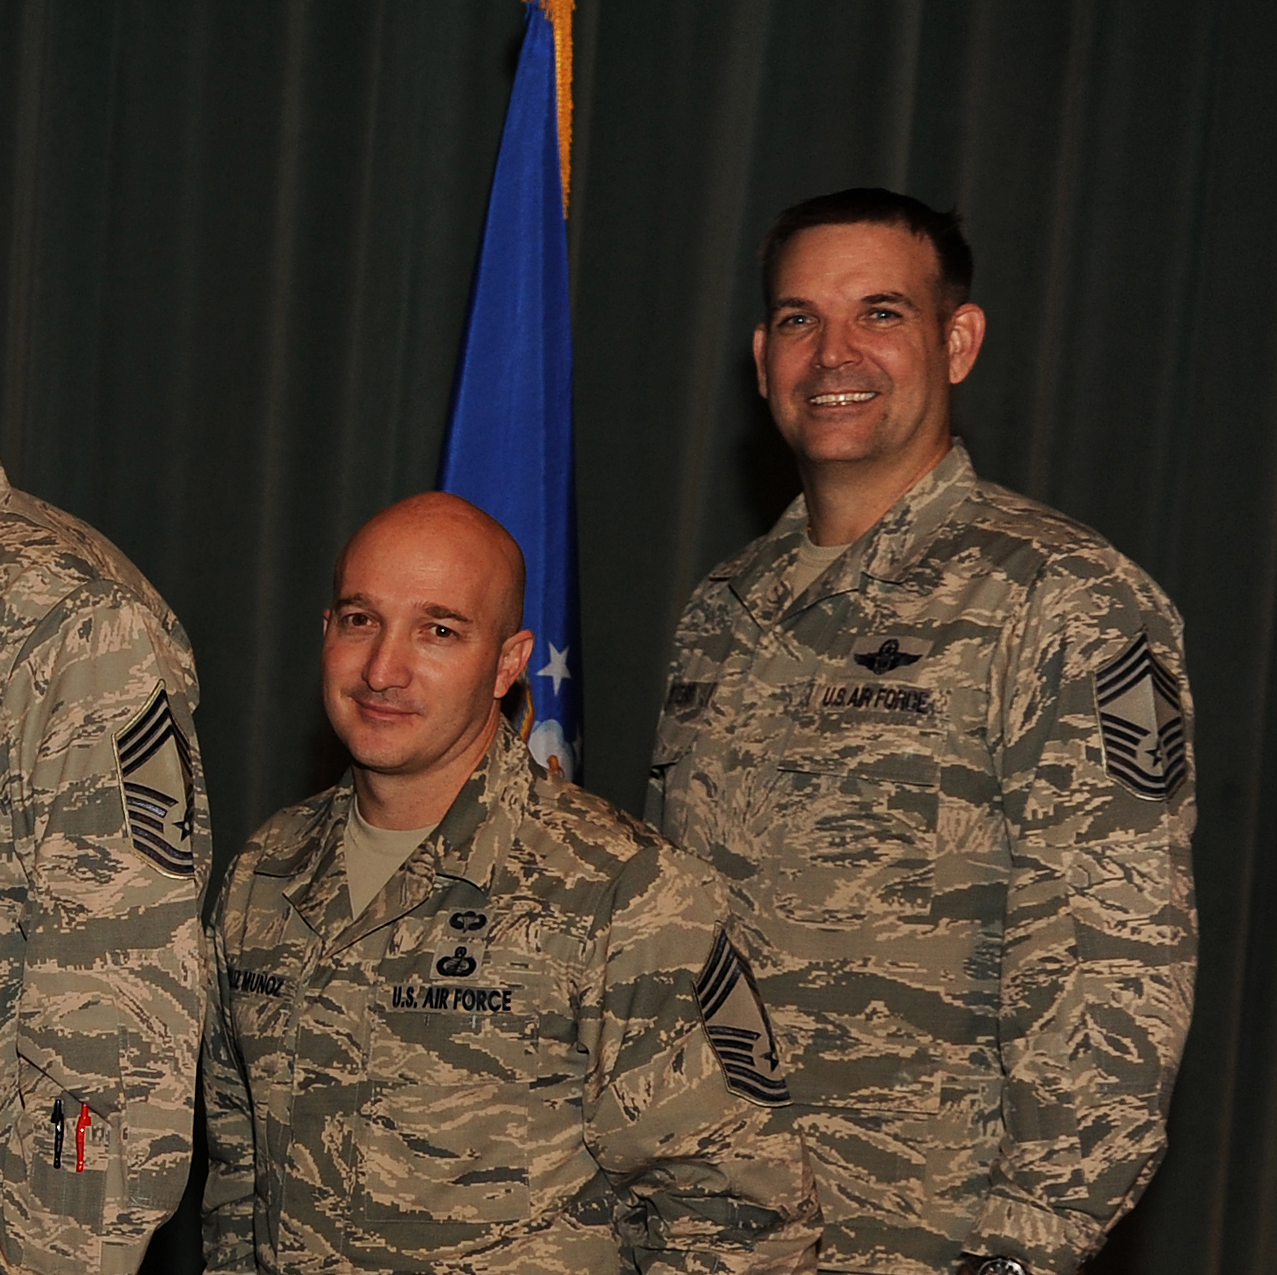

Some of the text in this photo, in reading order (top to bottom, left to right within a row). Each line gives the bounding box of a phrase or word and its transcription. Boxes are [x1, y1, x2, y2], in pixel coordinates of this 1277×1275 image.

[847, 687, 873, 708] AIR
[874, 688, 930, 714] FORCE
[393, 986, 512, 1012] U.S. AIR FORCE
